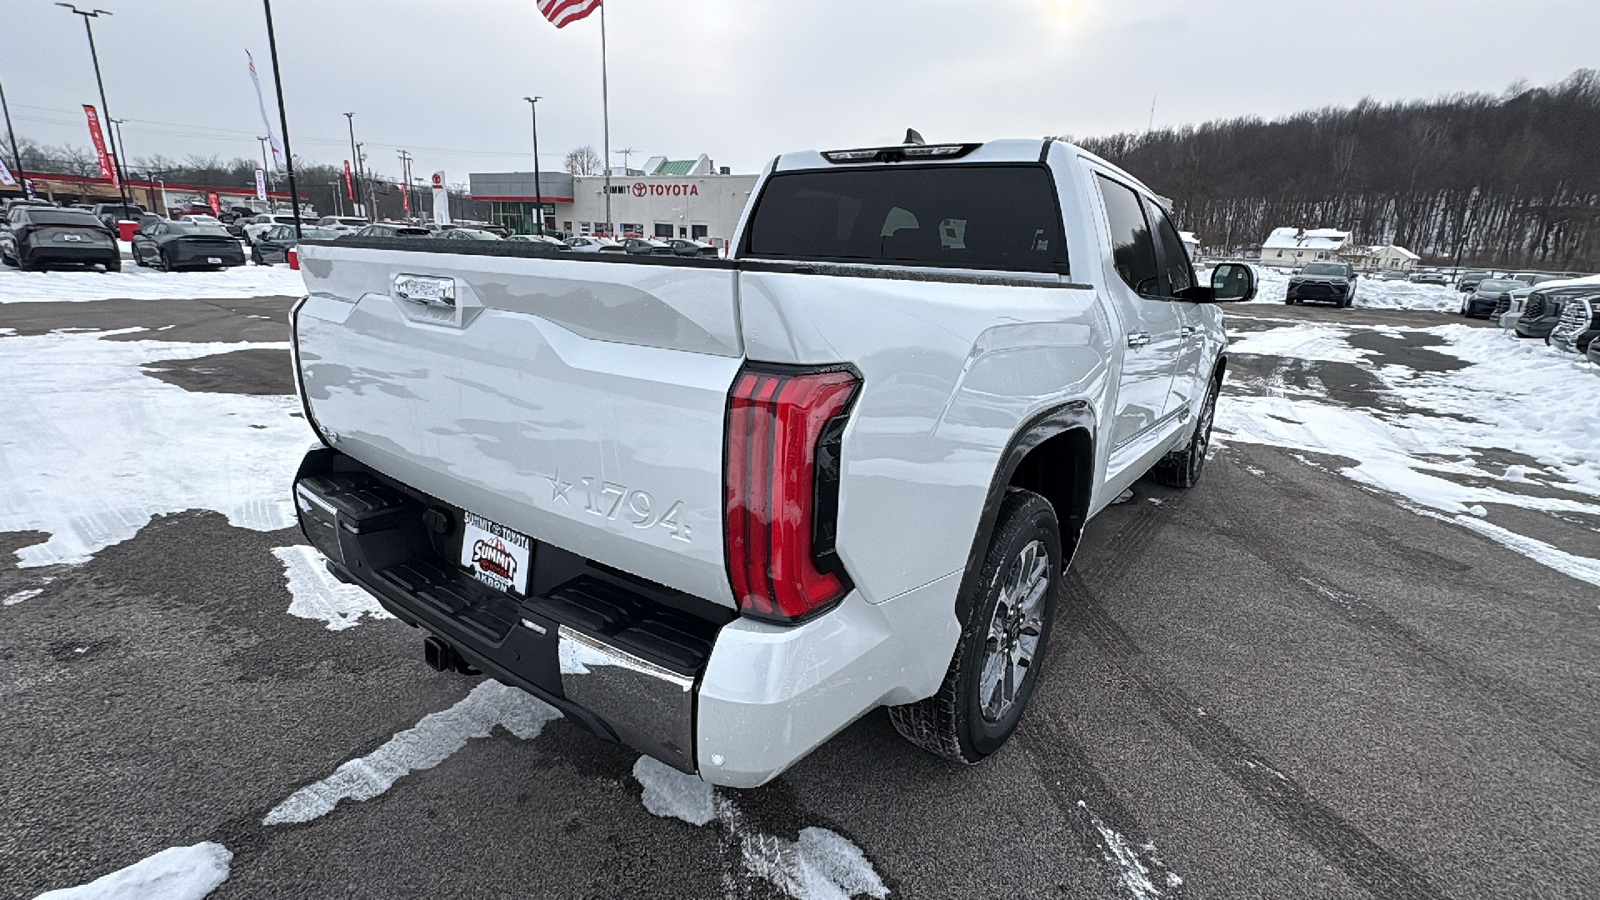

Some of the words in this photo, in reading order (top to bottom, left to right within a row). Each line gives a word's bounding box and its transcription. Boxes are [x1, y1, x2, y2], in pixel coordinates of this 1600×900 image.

[648, 184, 699, 196] TOYOTA
[581, 476, 693, 543] 1794
[464, 511, 493, 535] SUMMIT
[502, 528, 530, 551] TOYOTA
[472, 540, 516, 579] SUMMIT
[474, 571, 508, 593] AKRON
